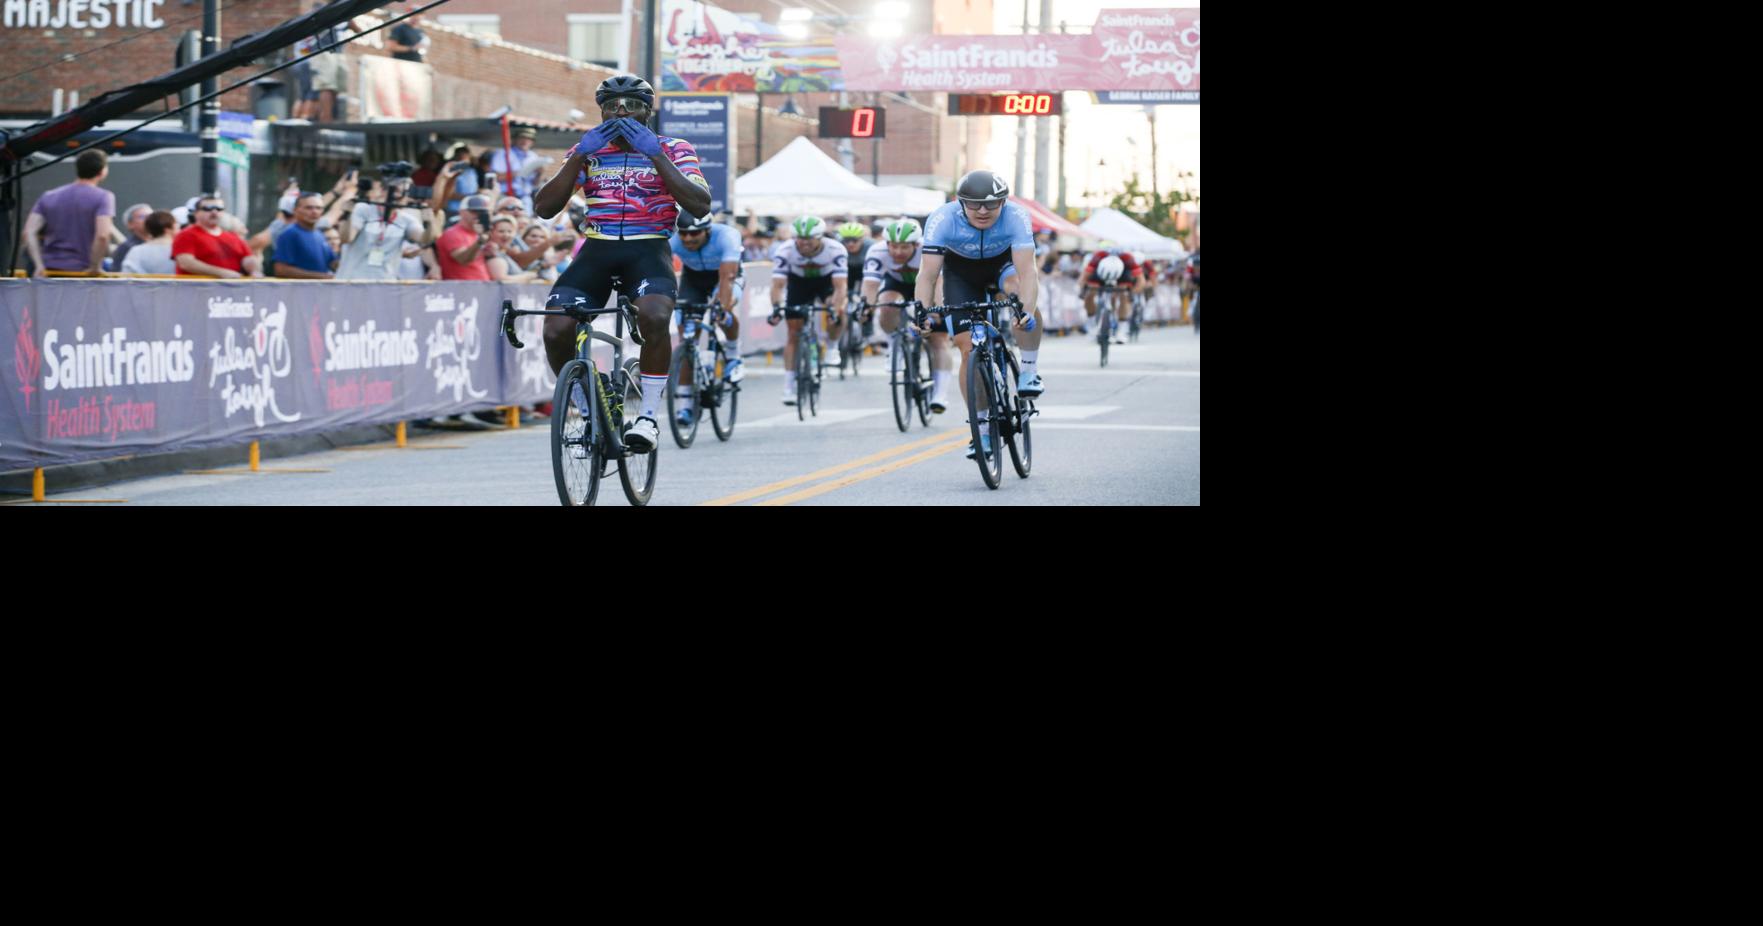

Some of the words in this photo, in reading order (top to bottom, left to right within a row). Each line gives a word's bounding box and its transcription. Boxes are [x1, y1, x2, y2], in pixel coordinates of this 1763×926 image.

[4, 0, 165, 28] MAJESTIC
[901, 43, 1059, 68] SaintFrancis
[902, 70, 953, 86] Health
[956, 70, 1012, 88] System
[1004, 95, 1051, 113] 0:00
[851, 108, 875, 137] 0
[43, 324, 194, 391] SaintFrancis
[325, 317, 419, 372] SaintFrancis
[47, 396, 100, 440] Health
[102, 394, 157, 443] System
